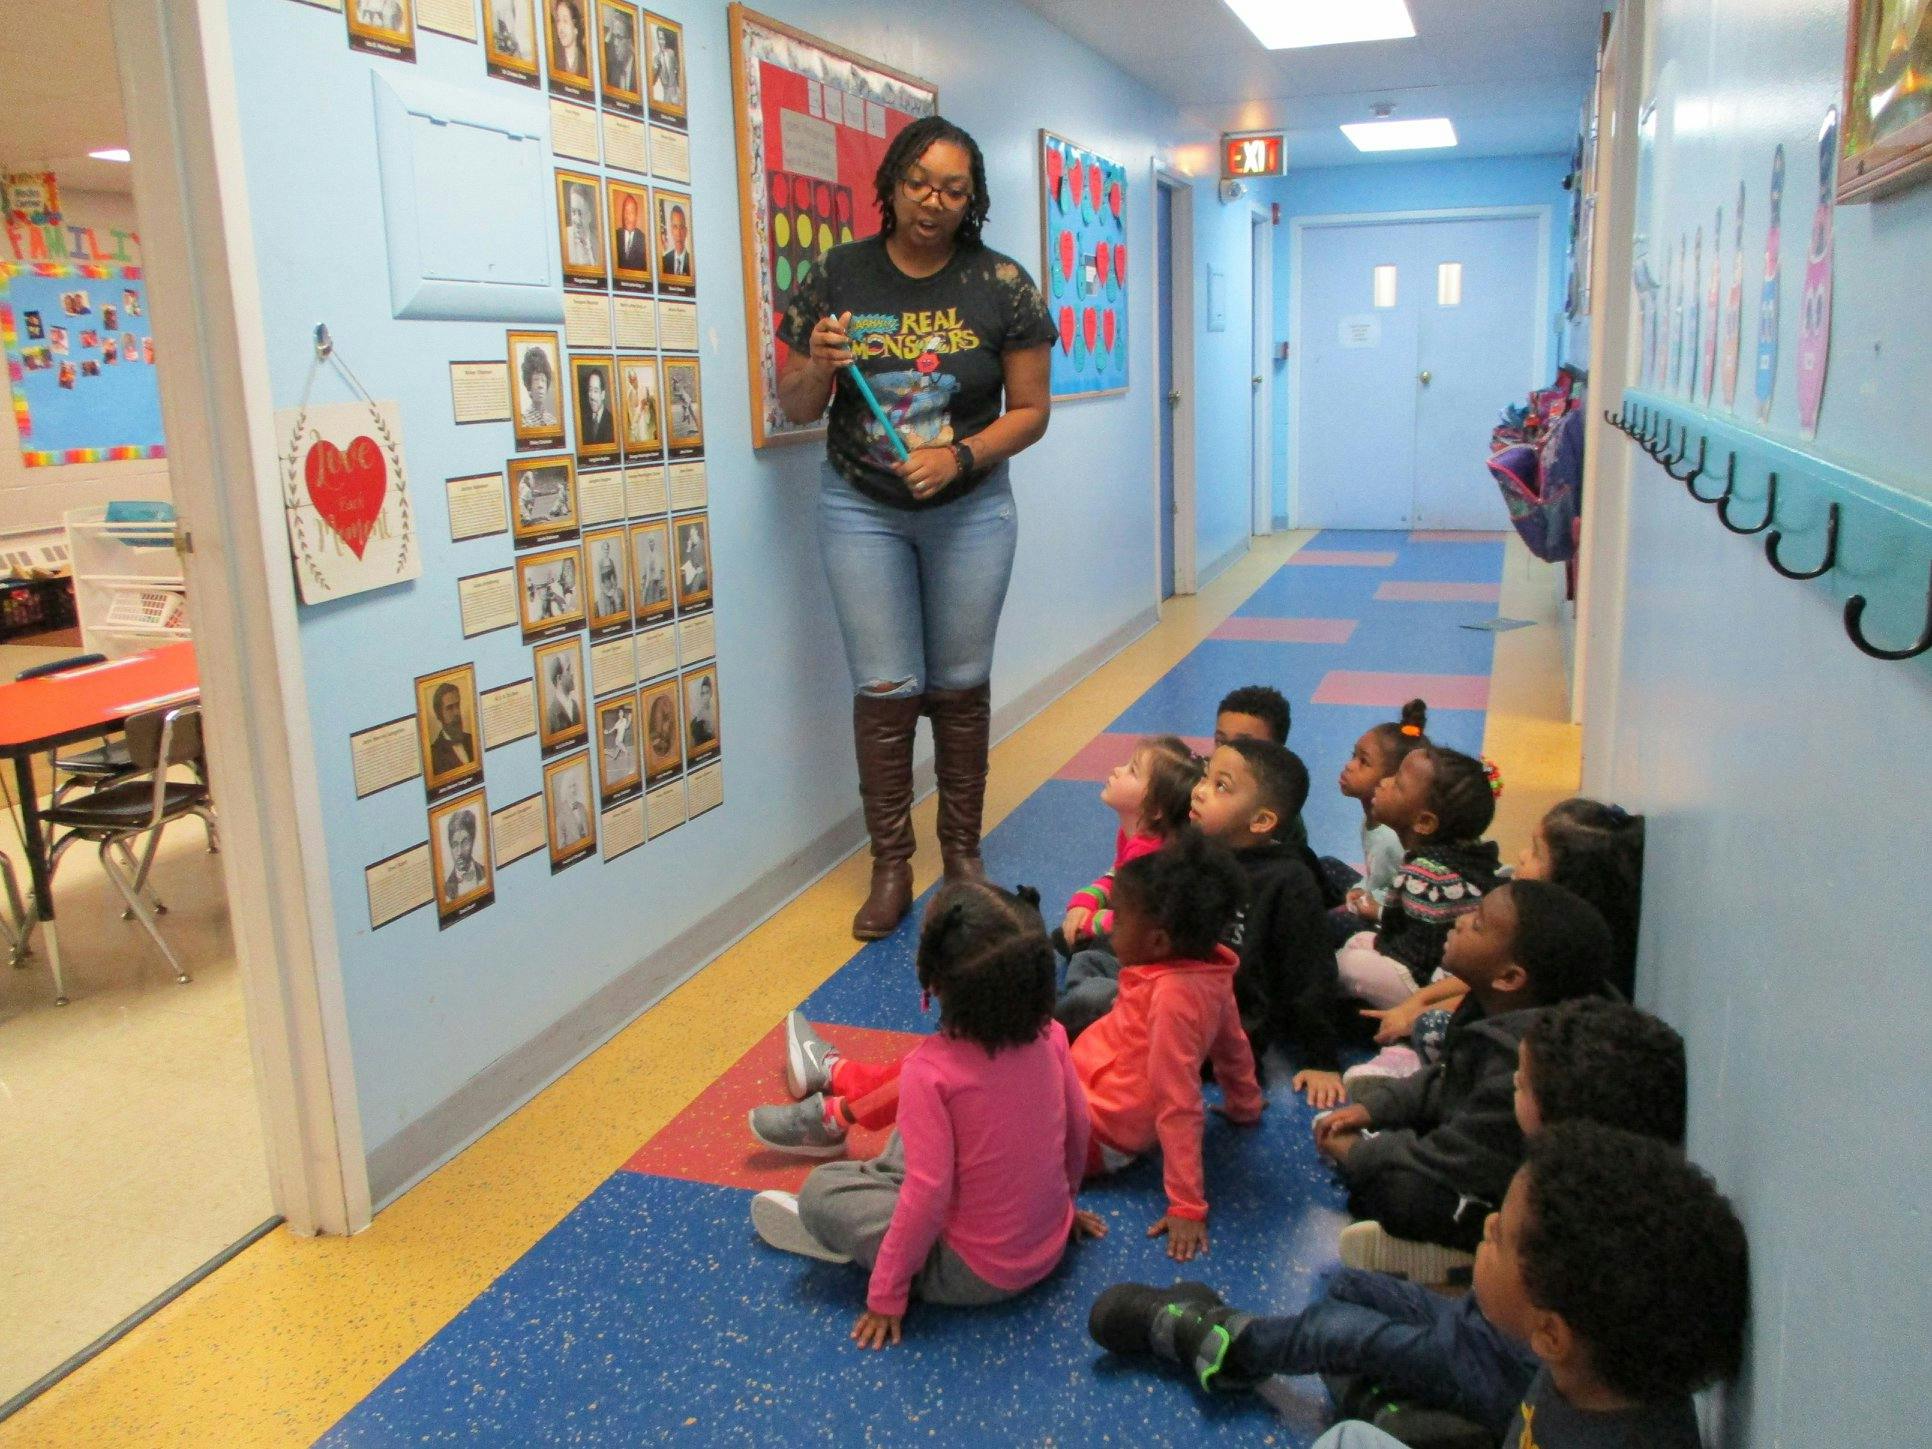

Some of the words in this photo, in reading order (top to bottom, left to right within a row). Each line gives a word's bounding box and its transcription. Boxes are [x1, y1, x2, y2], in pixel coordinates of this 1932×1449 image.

[1228, 137, 1280, 173] EXIT
[901, 307, 964, 335] REAL
[309, 429, 375, 487] Love
